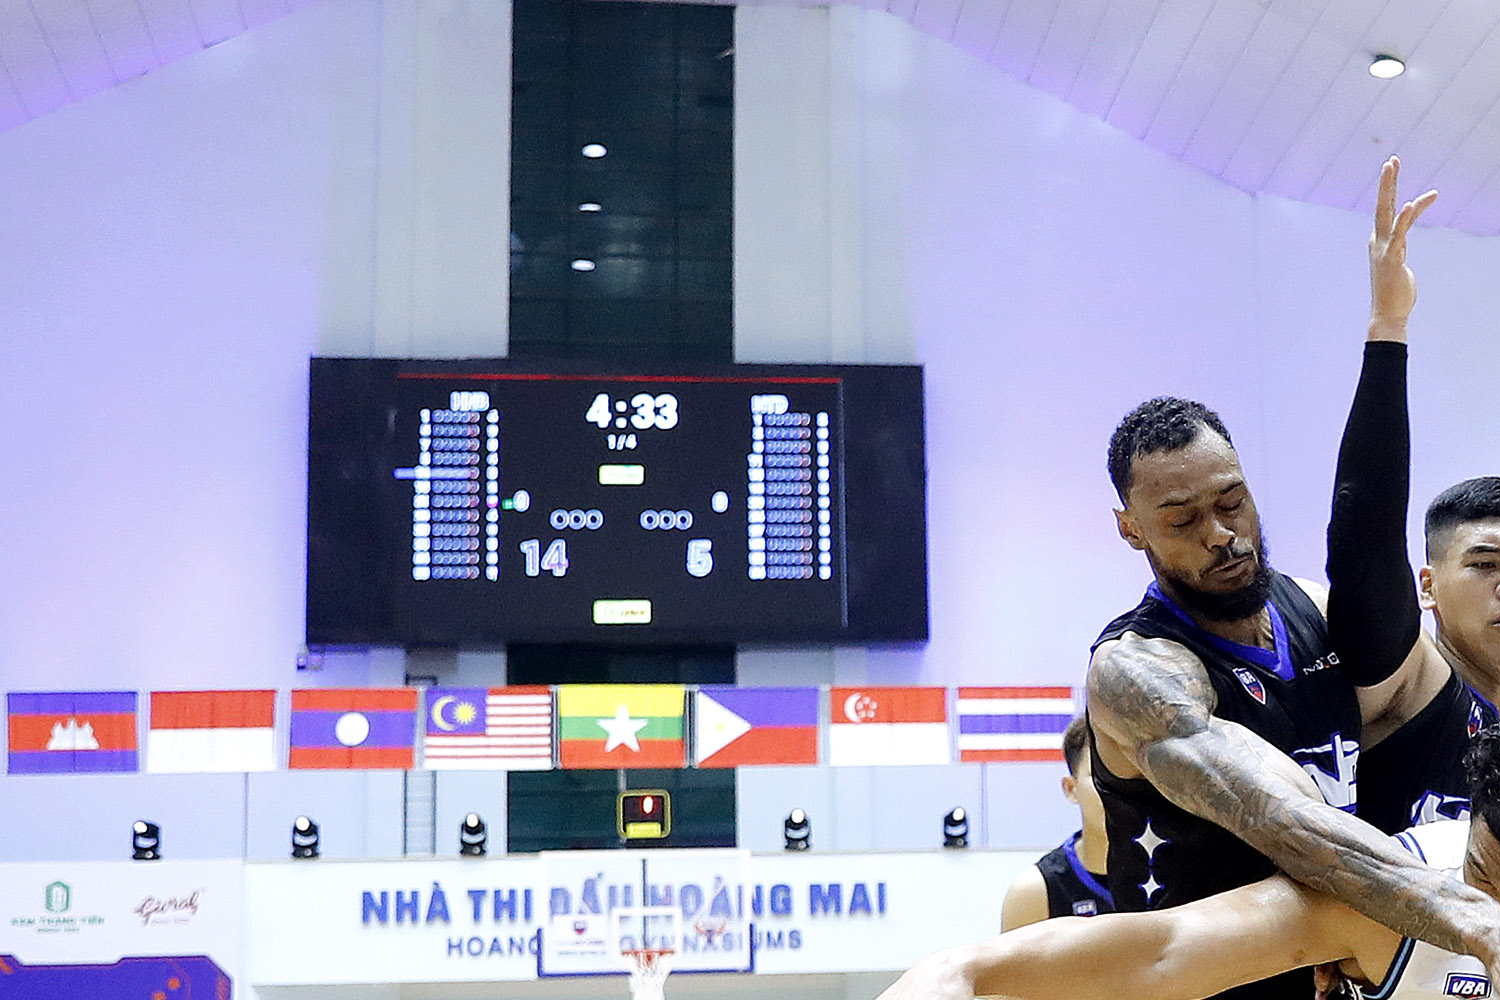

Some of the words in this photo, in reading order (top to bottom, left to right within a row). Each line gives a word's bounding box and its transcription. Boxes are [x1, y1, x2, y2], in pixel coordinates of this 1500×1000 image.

[585, 393, 679, 430] 4:33
[607, 433, 638, 450] 1/4
[519, 538, 569, 577] 14
[686, 538, 715, 577] 5
[362, 881, 451, 924] NHÀ
[467, 887, 533, 923] THI
[809, 882, 887, 917] MAI
[1451, 980, 1489, 997] VBA
